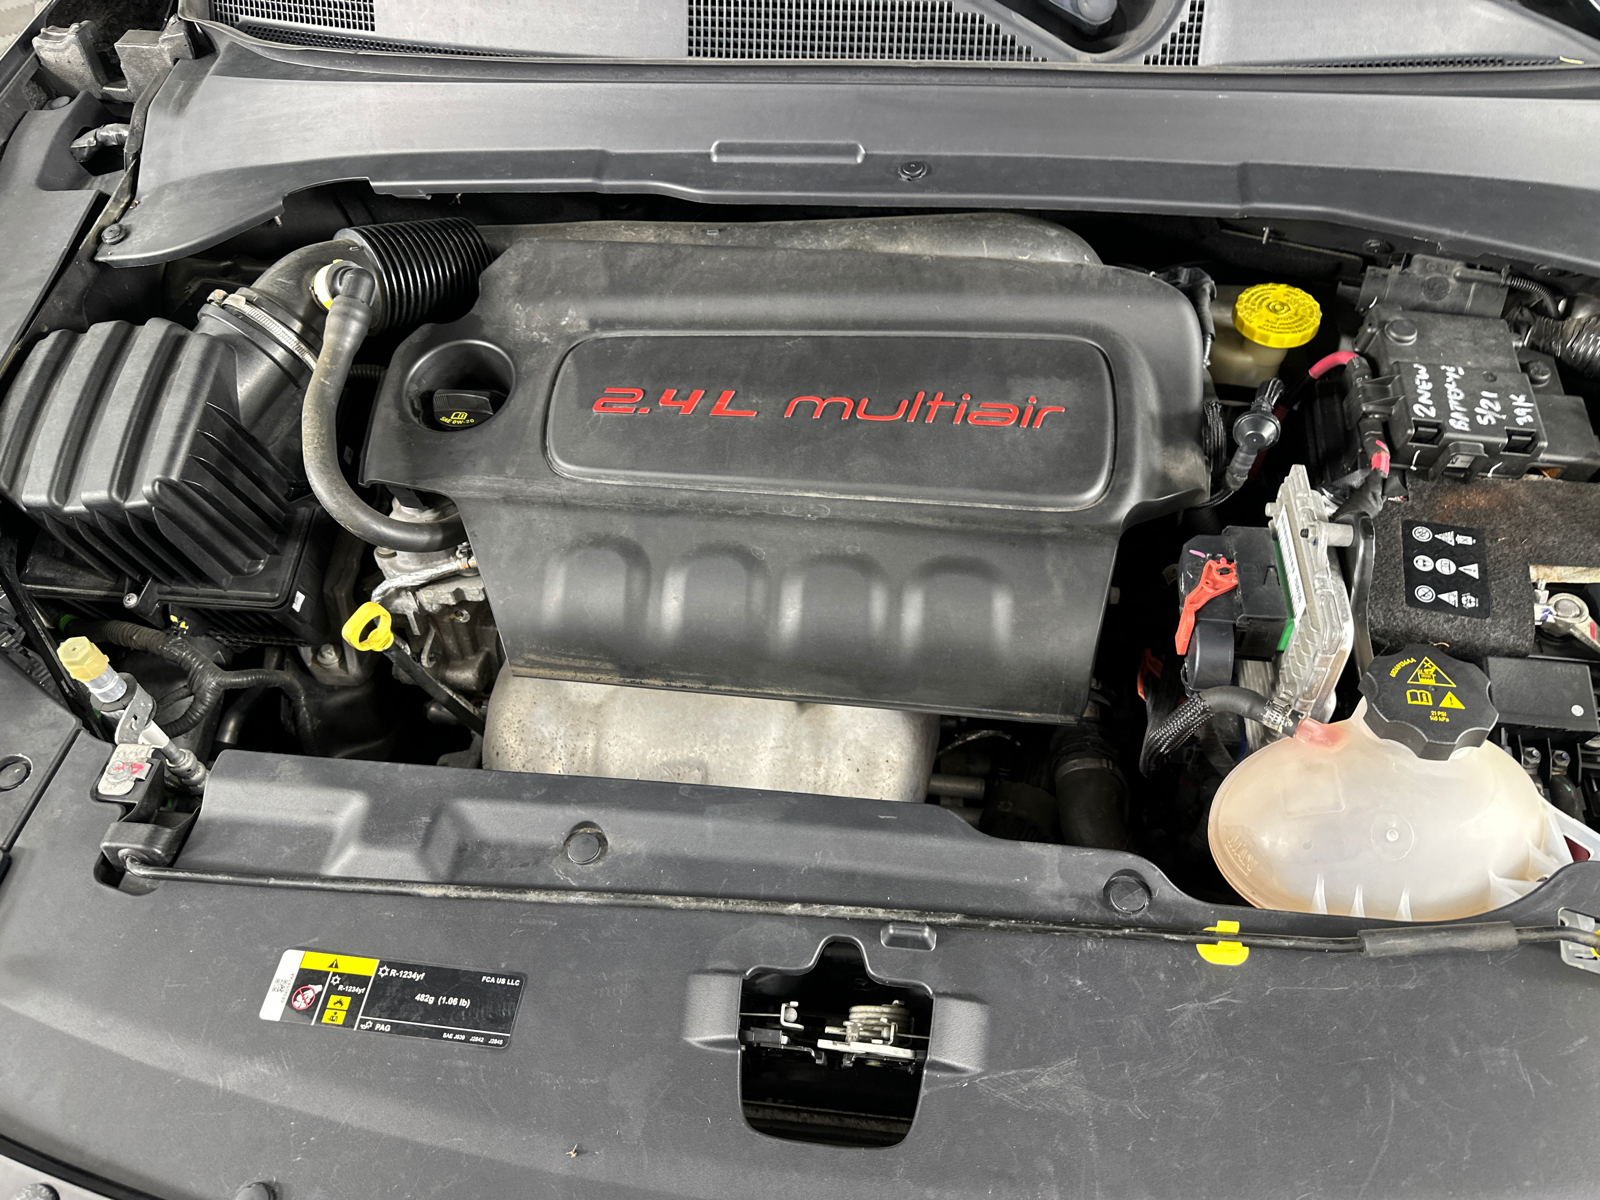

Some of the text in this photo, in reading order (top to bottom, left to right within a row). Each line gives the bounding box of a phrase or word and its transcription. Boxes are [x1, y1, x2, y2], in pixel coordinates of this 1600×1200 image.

[593, 387, 1066, 428] 2.4L multiair
[389, 968, 425, 982] R-1234yf
[481, 975, 521, 987] FCA US LLC
[337, 985, 366, 994] R-1234yf
[414, 993, 471, 1009] 482g (1.06 lb)
[374, 1024, 391, 1032] PAG
